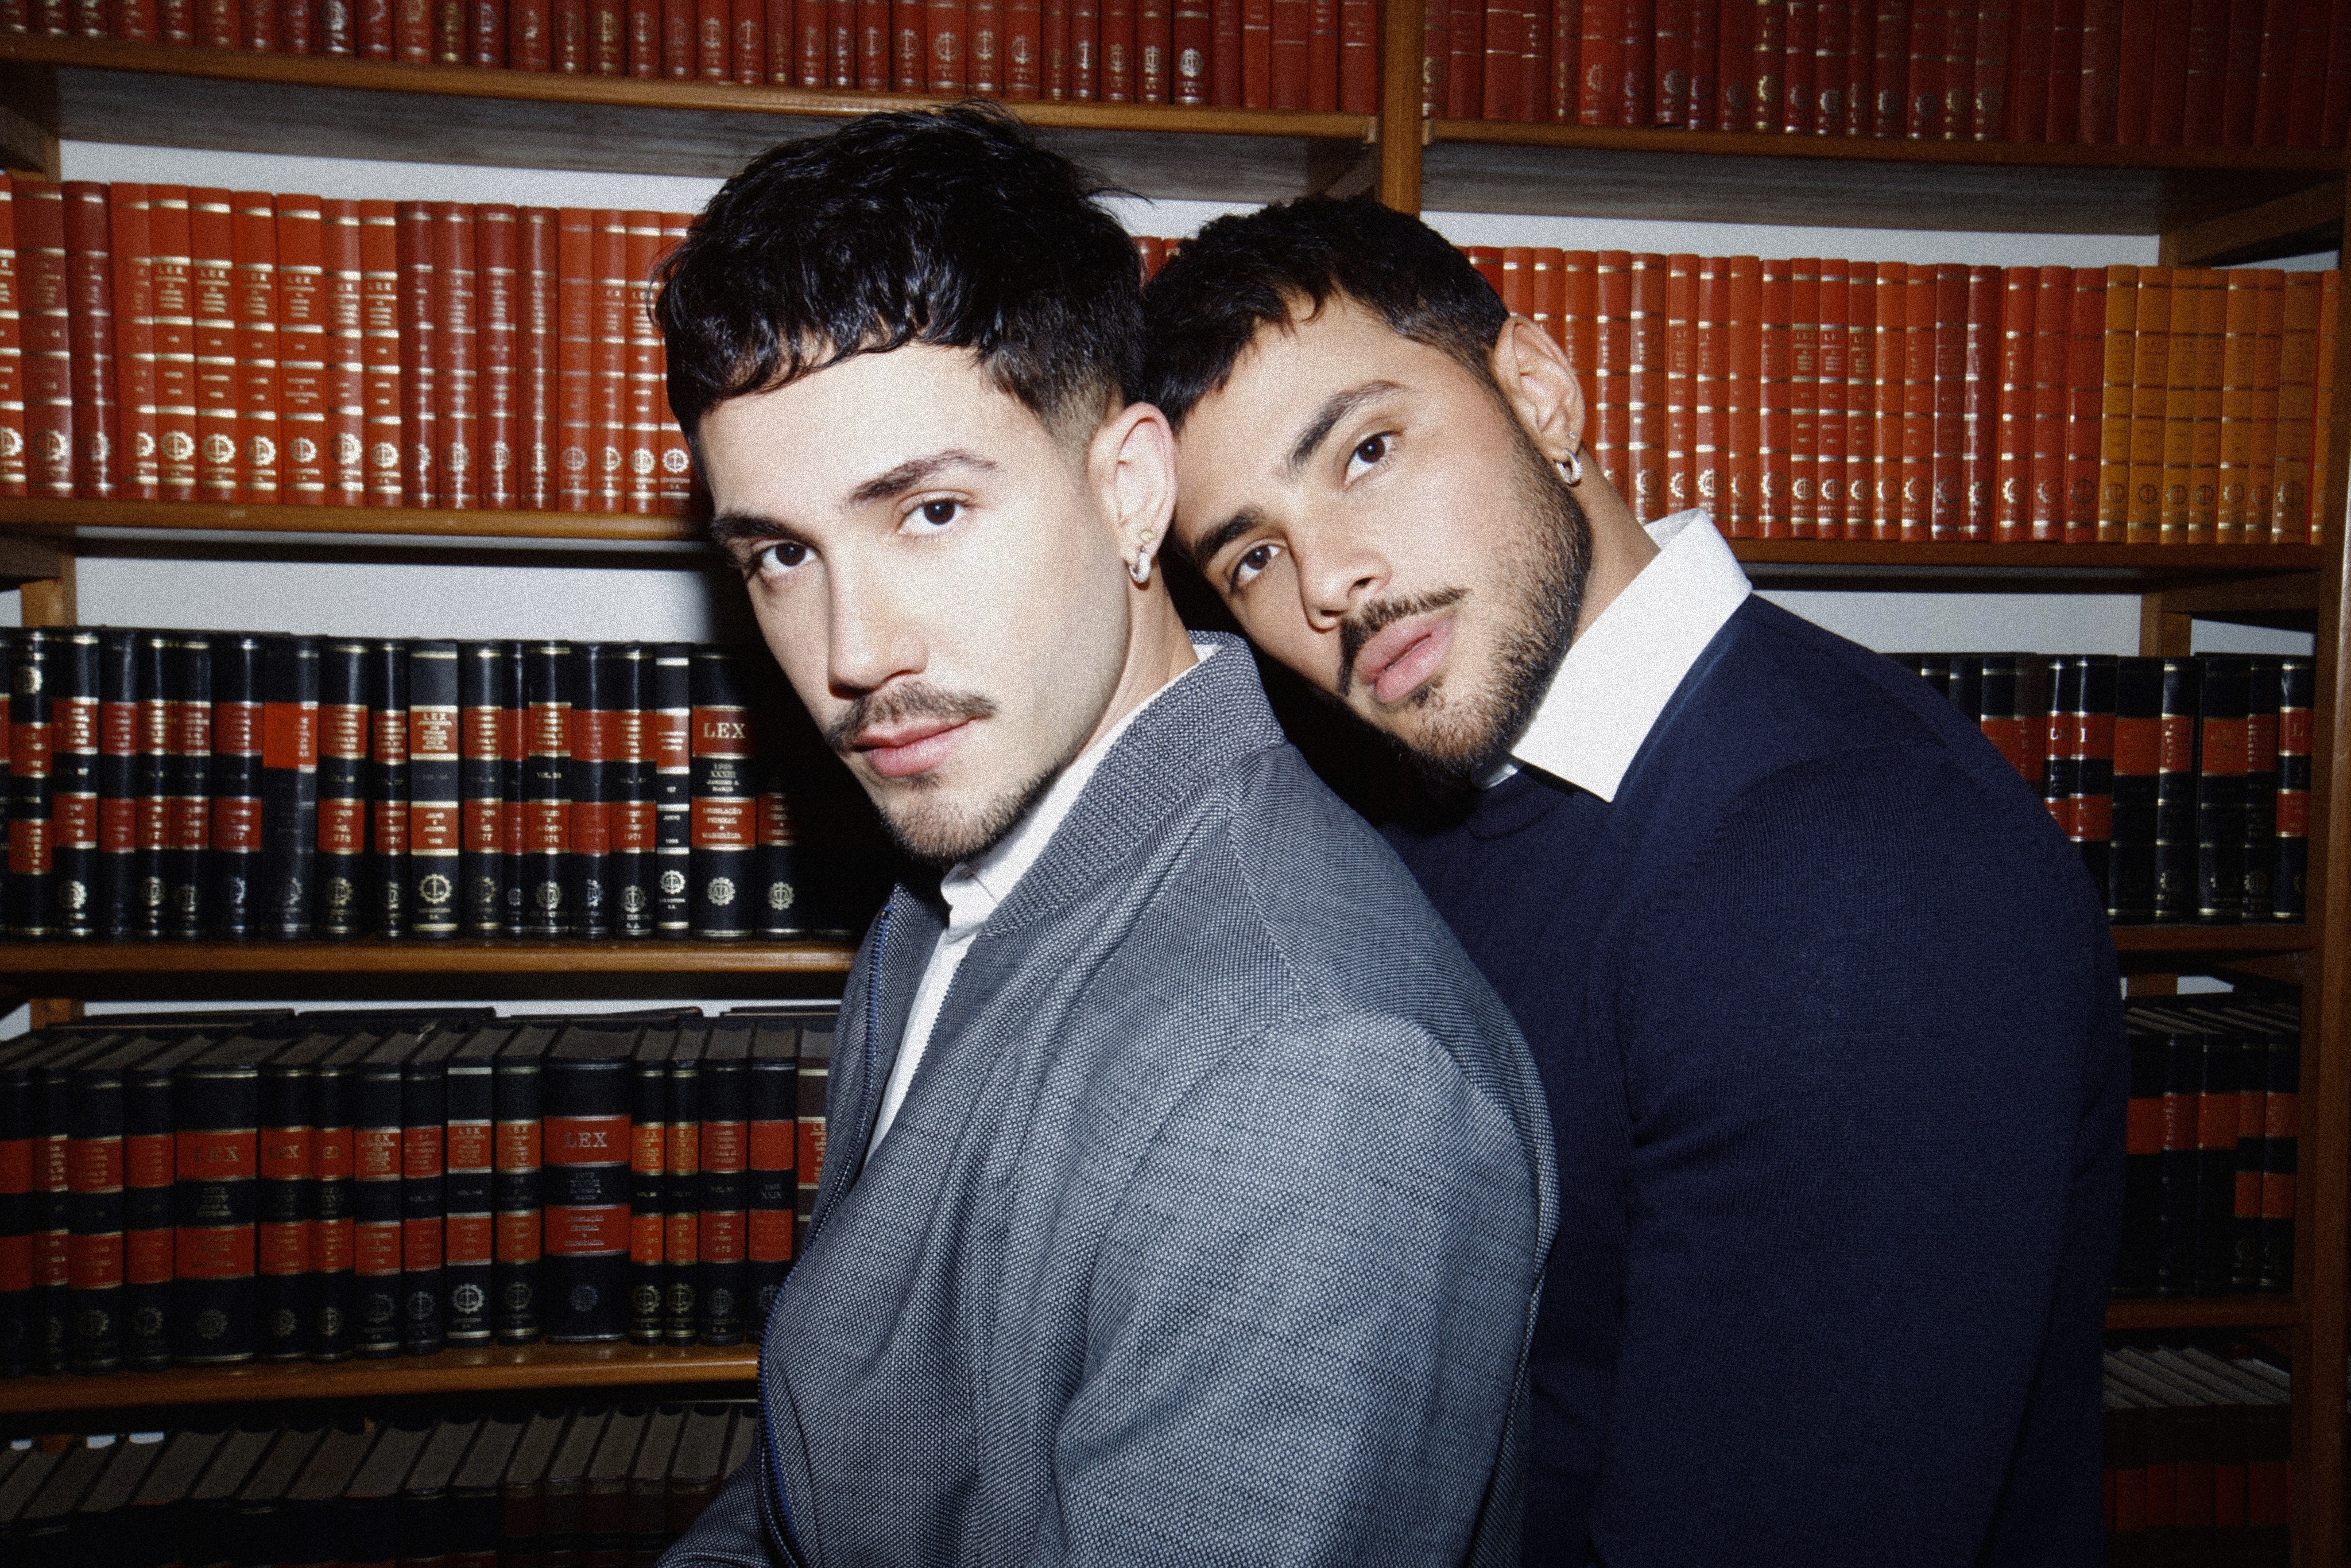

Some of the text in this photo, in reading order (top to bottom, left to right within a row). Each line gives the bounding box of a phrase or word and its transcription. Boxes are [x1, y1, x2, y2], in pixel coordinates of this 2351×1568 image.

[424, 712, 446, 721] LEX
[703, 721, 746, 739] LEX
[459, 1127, 480, 1135] LEX
[564, 1131, 608, 1148] LEX
[193, 1146, 239, 1163] LEX
